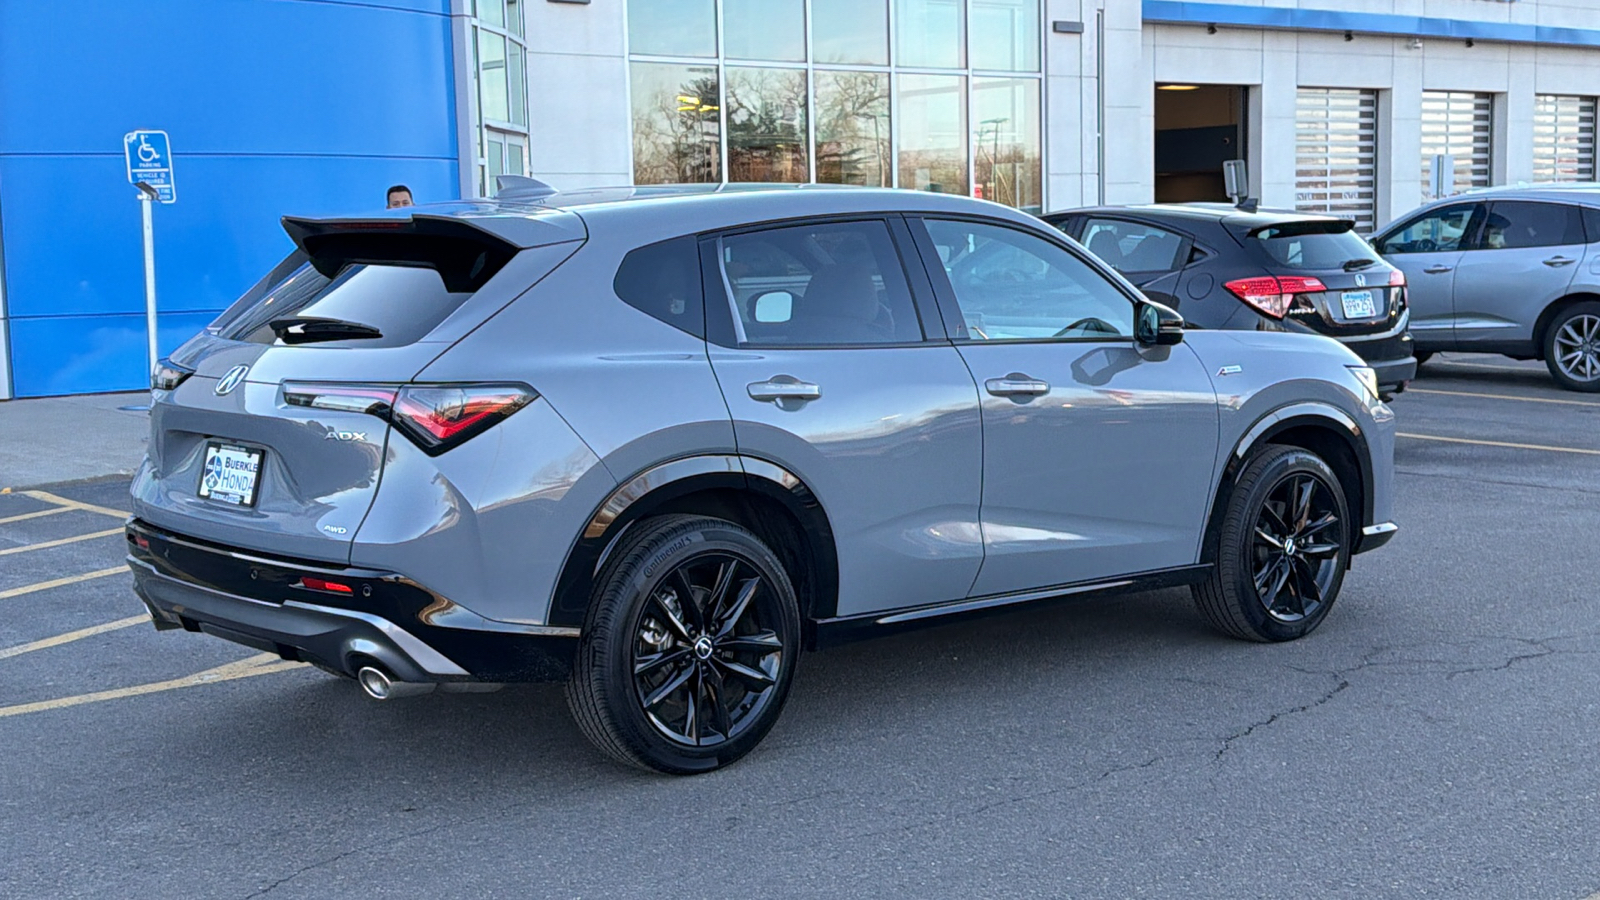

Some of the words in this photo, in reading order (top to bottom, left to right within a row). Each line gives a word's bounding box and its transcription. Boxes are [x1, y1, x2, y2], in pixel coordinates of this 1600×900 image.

[324, 431, 366, 441] ADX
[224, 457, 258, 472] BUERKLE
[221, 469, 253, 491] HONDA
[323, 525, 347, 534] AWD
